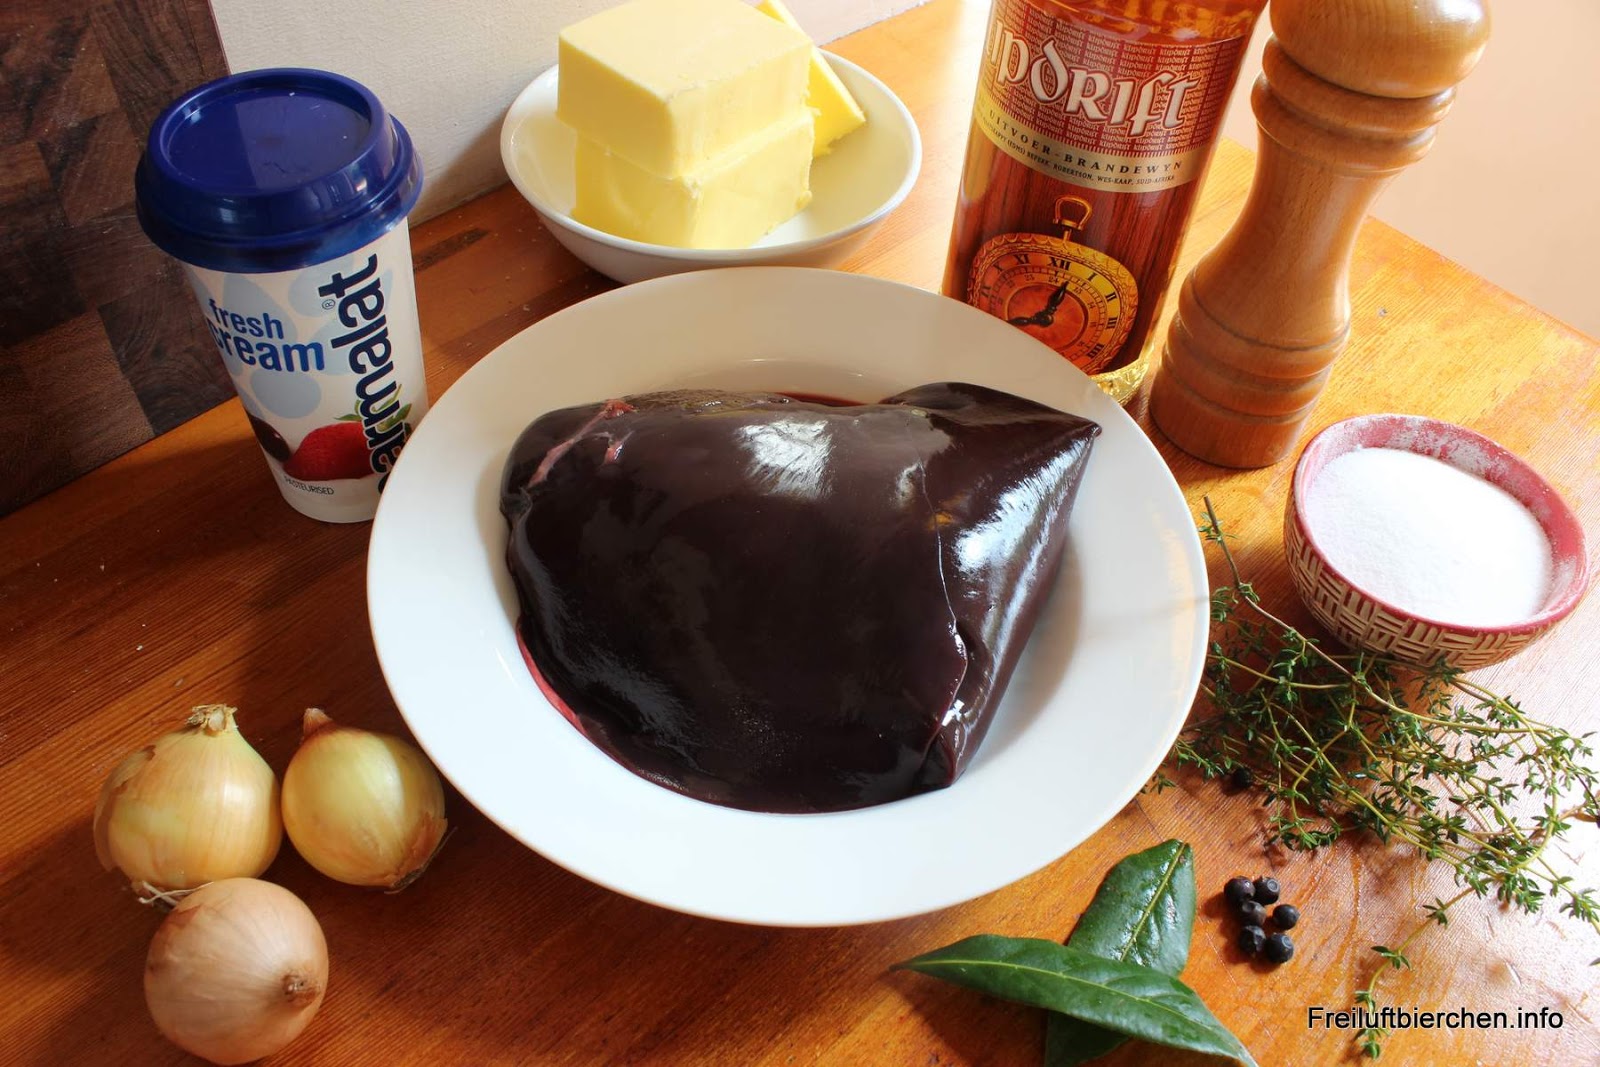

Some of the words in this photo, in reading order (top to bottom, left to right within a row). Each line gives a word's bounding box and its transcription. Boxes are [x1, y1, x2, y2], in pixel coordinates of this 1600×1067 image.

[205, 317, 326, 373] cream
[209, 298, 285, 340] fresh
[318, 253, 405, 494] armalat
